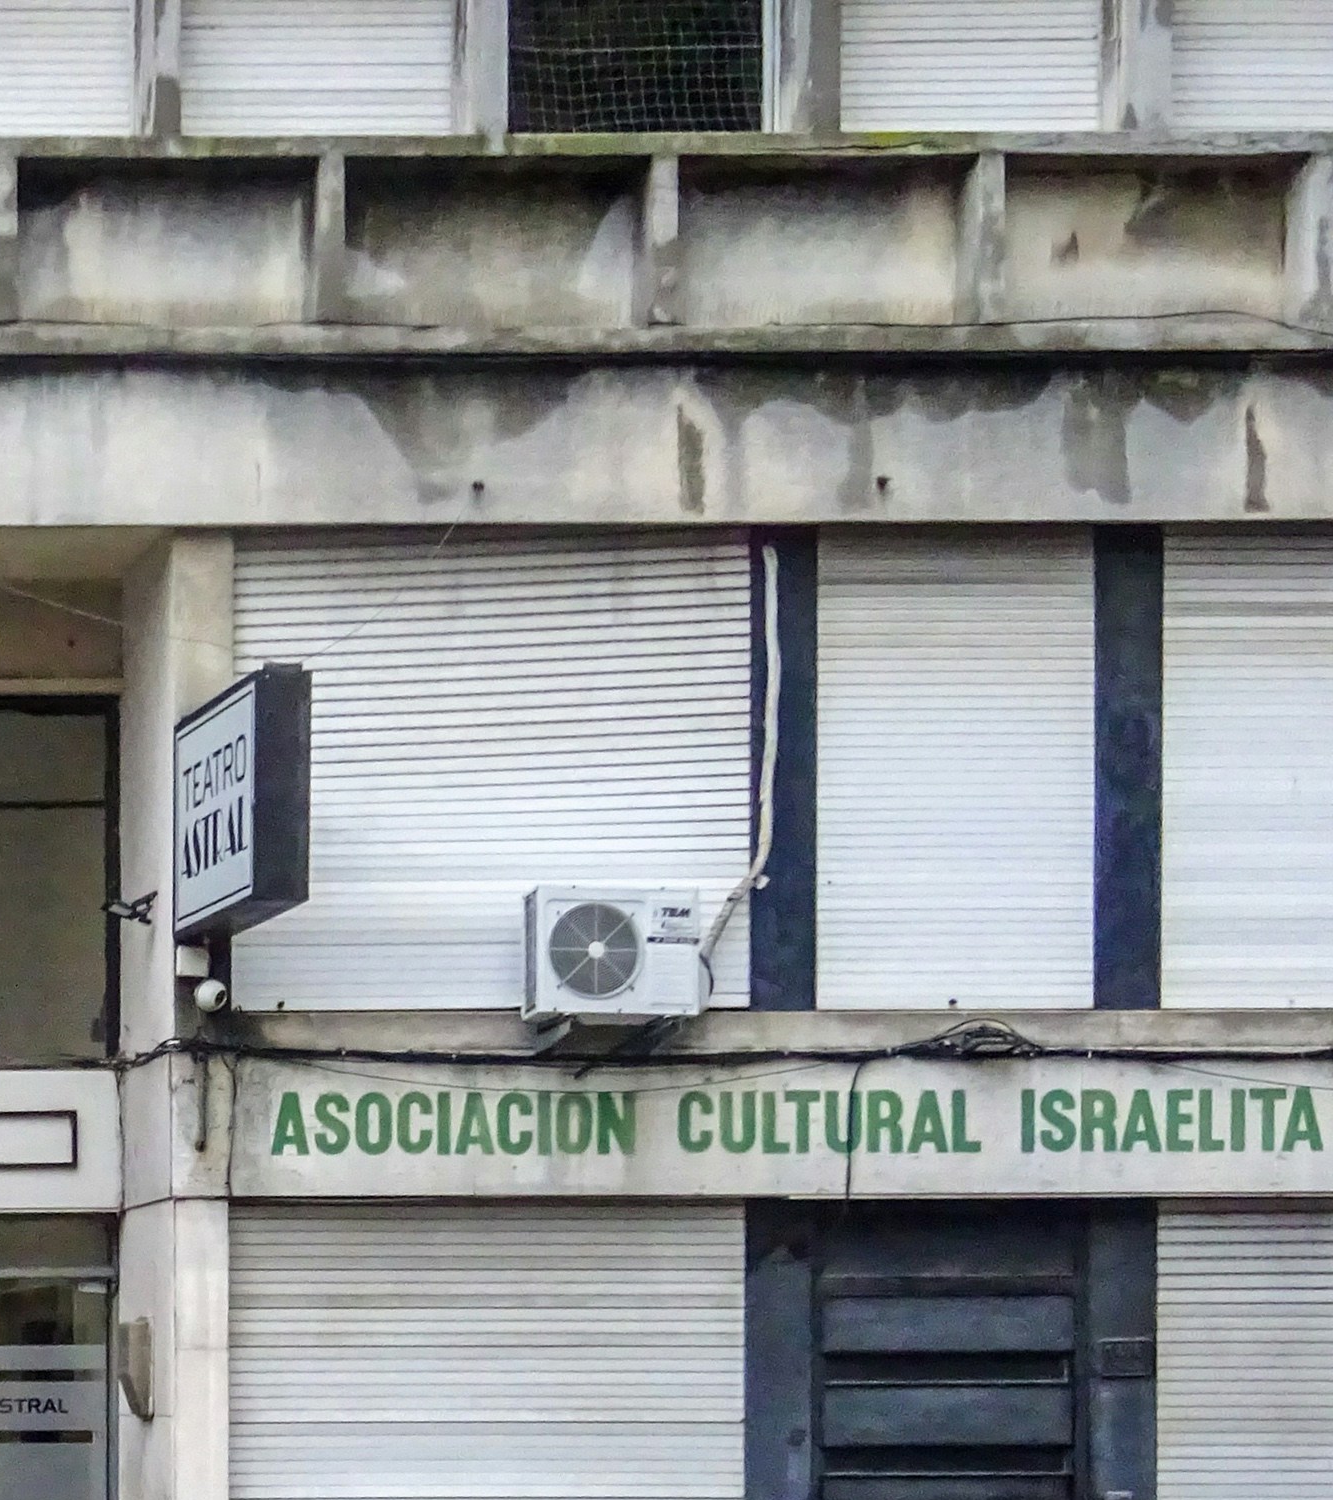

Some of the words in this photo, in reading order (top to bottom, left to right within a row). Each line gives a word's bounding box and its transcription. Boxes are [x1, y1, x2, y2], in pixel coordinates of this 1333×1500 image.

[182, 733, 247, 812] TEATRO
[181, 795, 248, 879] ASTRAL
[270, 1090, 637, 1156] ASOCIACION
[677, 1089, 981, 1156] CULTURAL
[1020, 1086, 1323, 1153] ISRAELITA
